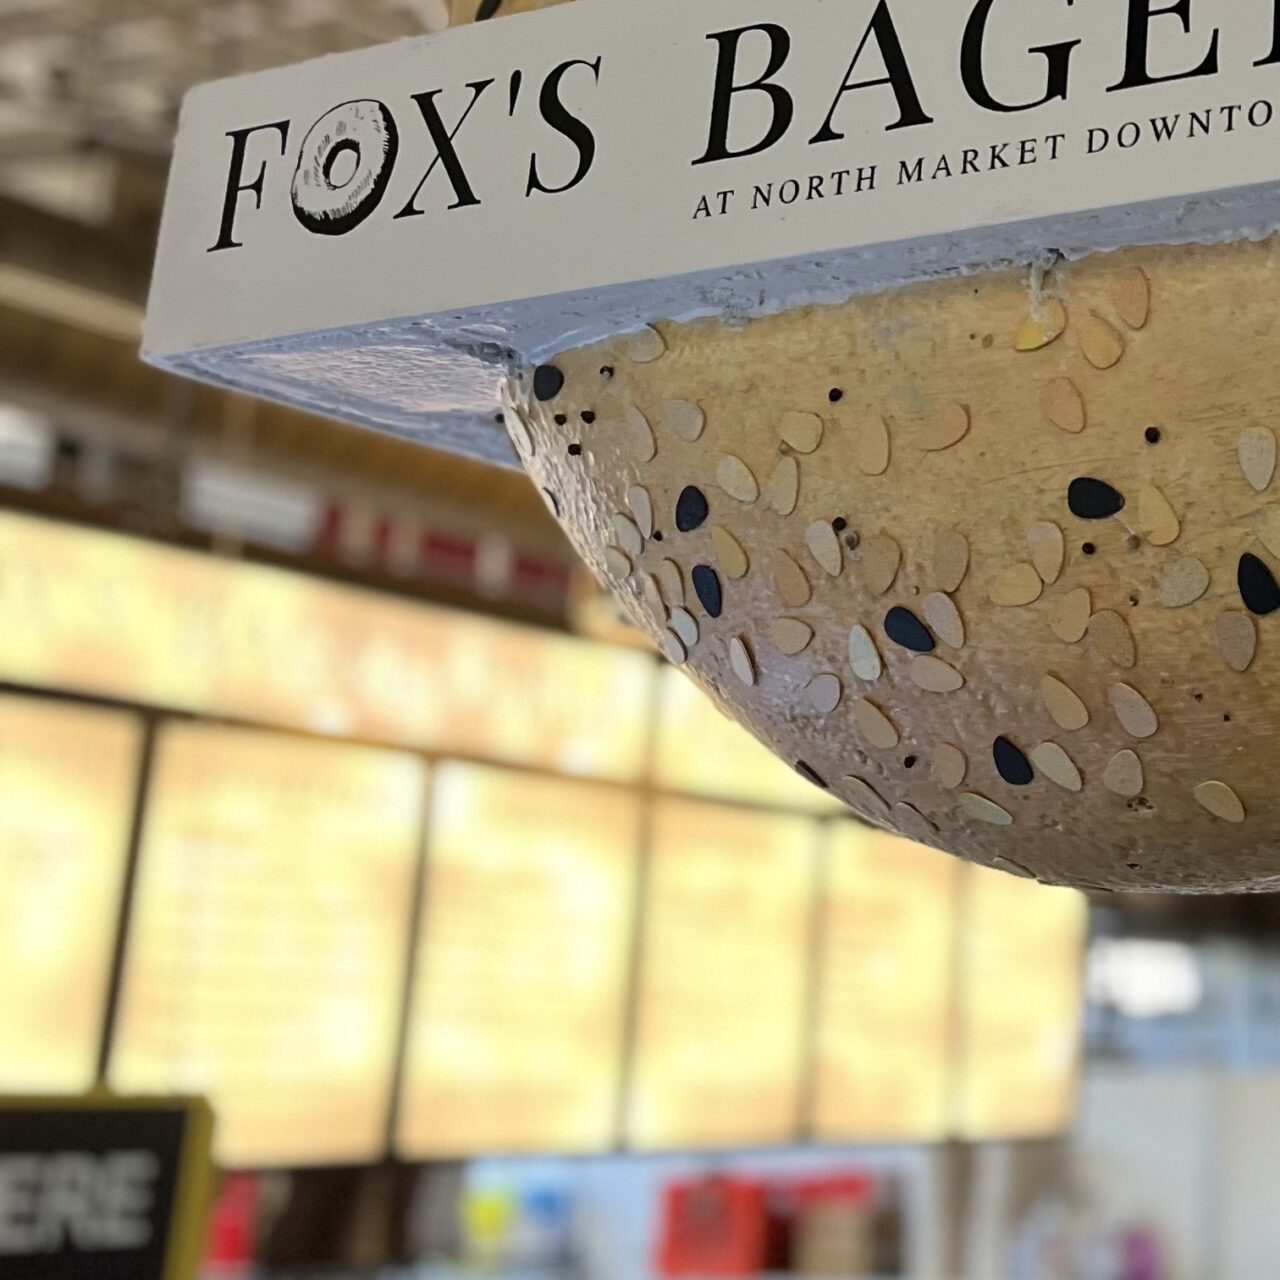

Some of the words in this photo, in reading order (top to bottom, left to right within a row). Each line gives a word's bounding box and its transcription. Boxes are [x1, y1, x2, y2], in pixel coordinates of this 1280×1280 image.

[206, 55, 602, 253] FOX'S
[691, 189, 735, 220] AT
[750, 157, 877, 210] NORTH
[897, 133, 1066, 185] MARKET
